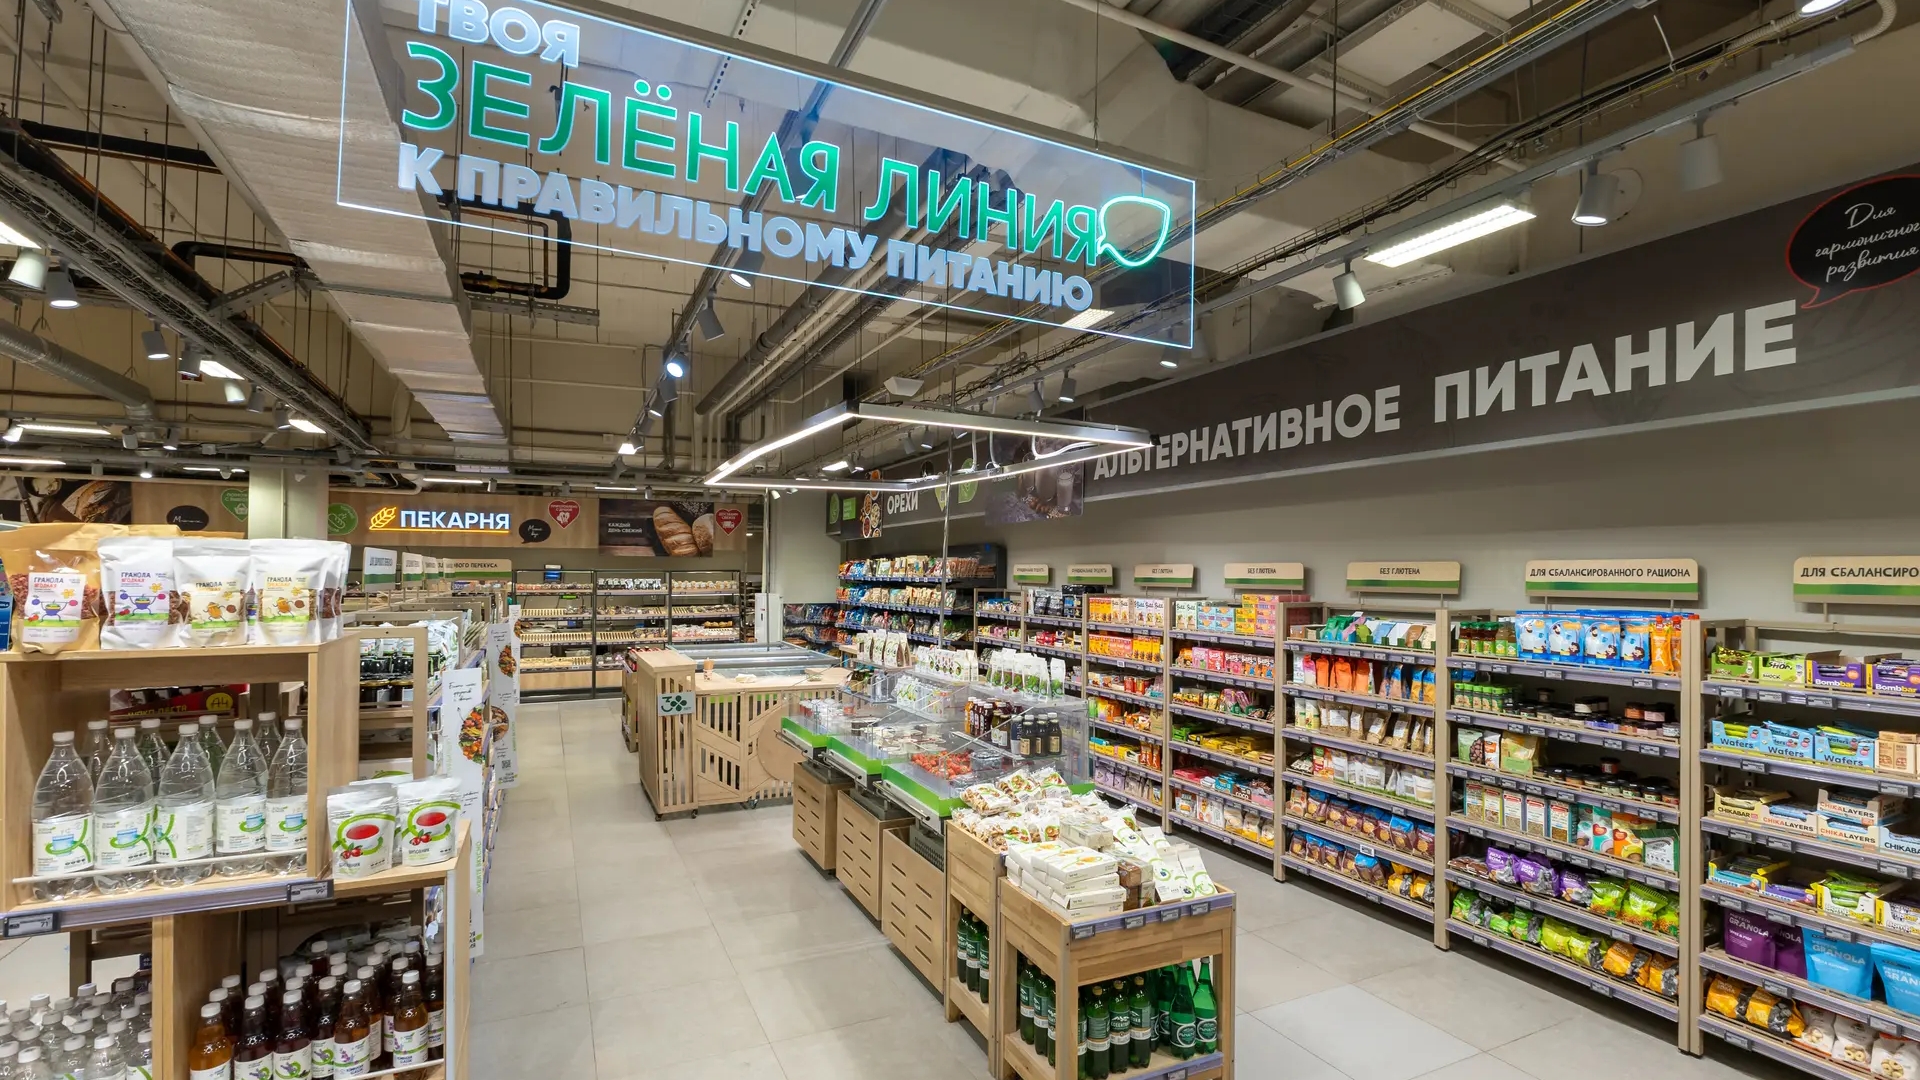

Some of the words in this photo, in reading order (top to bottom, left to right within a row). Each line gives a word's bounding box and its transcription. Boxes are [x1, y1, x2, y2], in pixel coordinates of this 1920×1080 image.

[401, 41, 840, 213] ЗЕЛЁНАЯ
[864, 156, 1098, 267] ЛИНИЯ
[1844, 202, 1897, 230] Для
[398, 142, 445, 196] К
[456, 154, 878, 270] ПРАВИЛЬНОМУ
[886, 238, 1094, 312] ПИТАНИЮ
[1825, 246, 1920, 283] развития
[1093, 384, 1401, 481] АЛЬТЕРНАТИВНОЕ
[1434, 299, 1797, 424] ПИТАНИЕ
[886, 490, 919, 515] ОРЕХИ
[400, 510, 511, 530] ПЕКАРНЯ
[1379, 567, 1390, 575] БЕЗ
[1391, 567, 1421, 575] ГЛЮТЕНА
[1530, 568, 1546, 577] ДЛЯ
[1549, 568, 1643, 577] СБАЛАНСИРОВАННОГО
[1646, 568, 1691, 578] РАЦИОНА
[1801, 567, 1826, 578] ДЛЯ
[1815, 678, 1855, 689] Bombbar
[1875, 683, 1917, 693] Bombbar
[1720, 738, 1754, 749] Wafers
[1768, 745, 1805, 759] Wafers
[1824, 754, 1864, 767] Wafers
[1717, 806, 1750, 818] CHIKABAR
[1820, 801, 1875, 818] CHIKALAYERS
[1763, 817, 1814, 832] CHIKALAYERS
[1820, 827, 1876, 844] CHIKALAYERS
[1729, 916, 1769, 937] GRANOLA
[1812, 944, 1866, 965] GRANOLA
